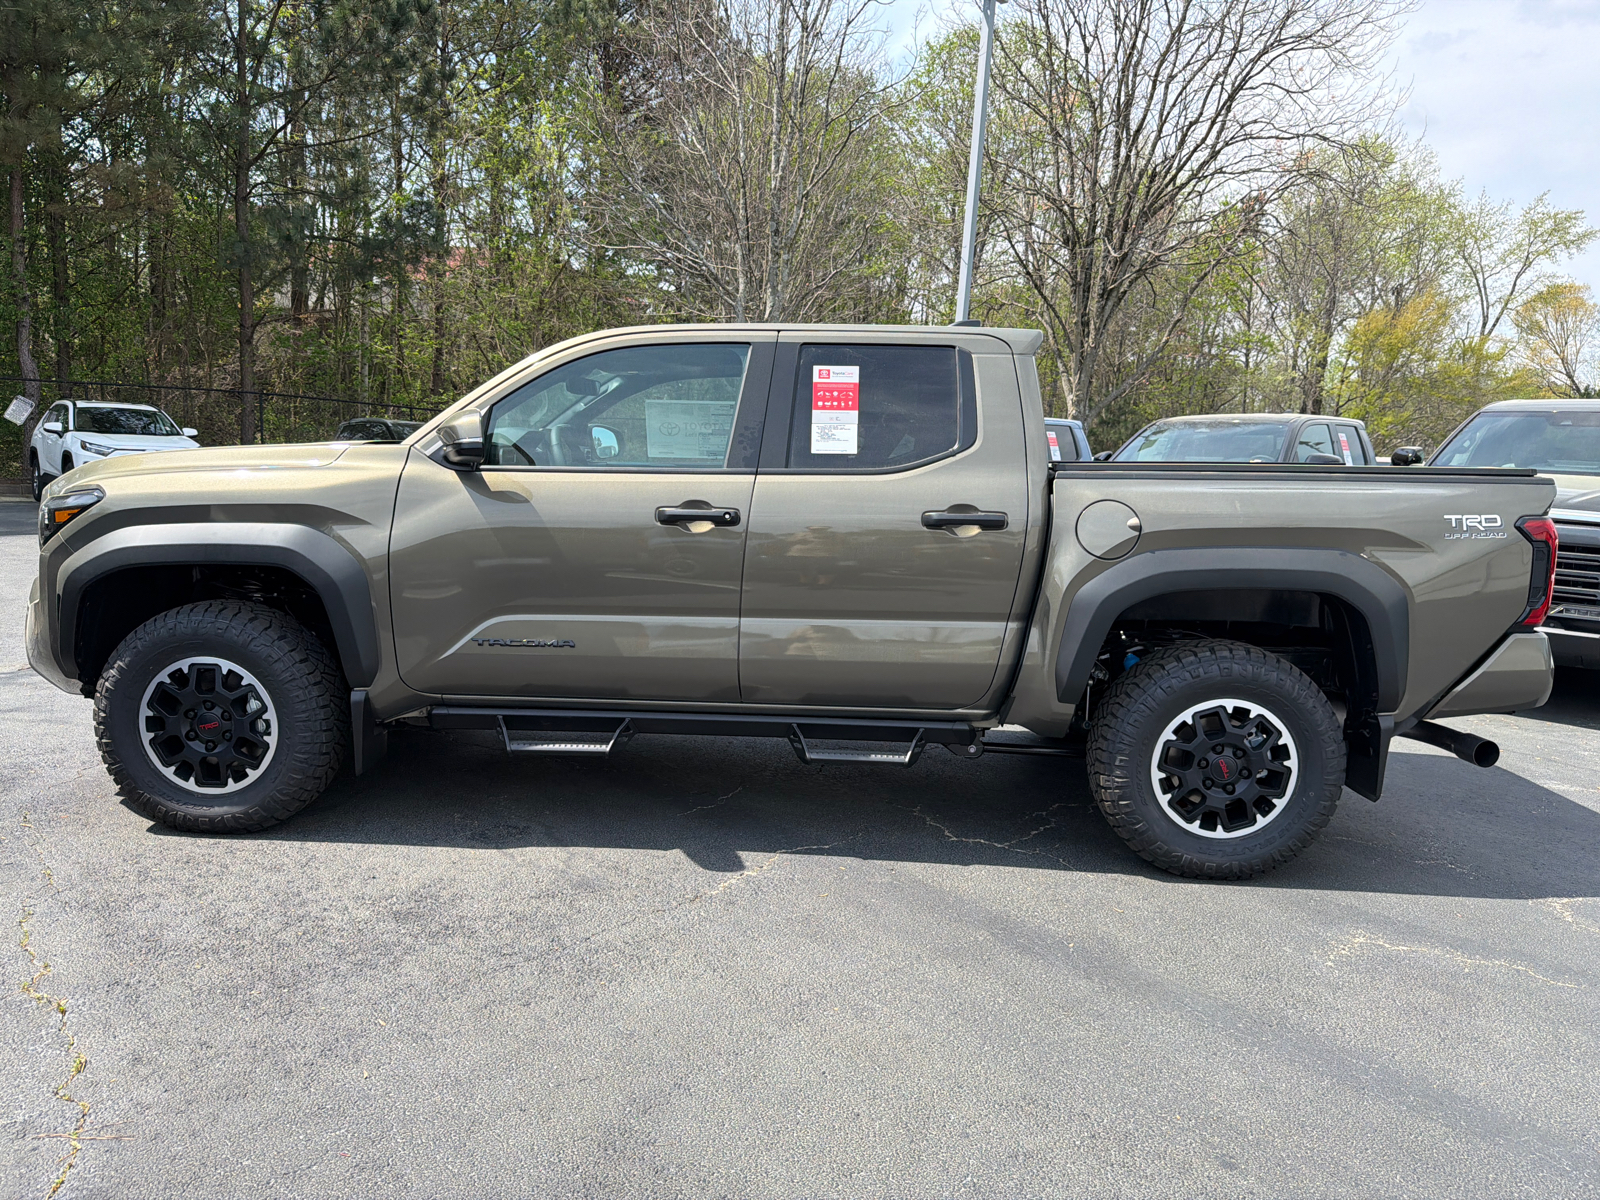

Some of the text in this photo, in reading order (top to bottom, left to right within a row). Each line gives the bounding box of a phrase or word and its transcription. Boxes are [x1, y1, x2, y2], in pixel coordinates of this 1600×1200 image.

[683, 422, 725, 431] TOYOTA
[1443, 514, 1503, 531] TRD
[471, 638, 576, 648] TACOMA
[199, 721, 219, 730] TRD
